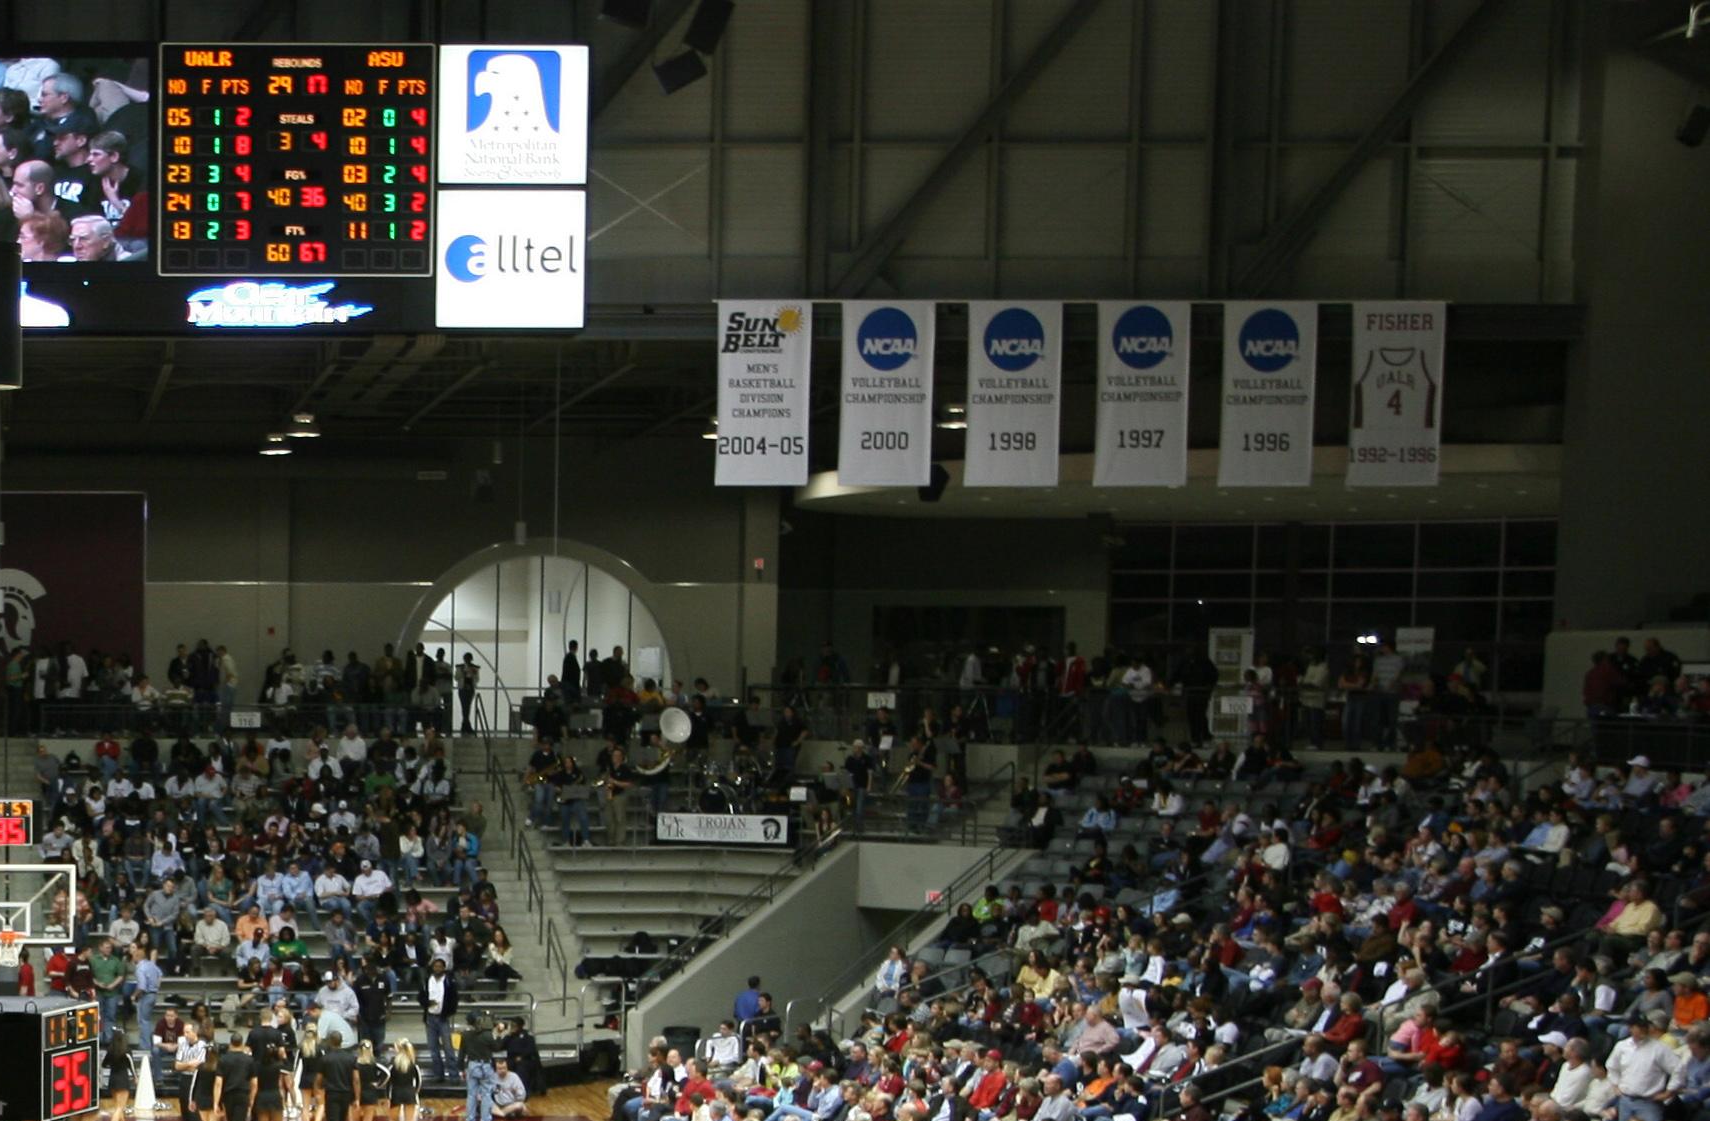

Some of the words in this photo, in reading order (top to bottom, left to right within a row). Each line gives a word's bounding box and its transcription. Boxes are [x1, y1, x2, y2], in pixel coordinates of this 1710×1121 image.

[184, 51, 233, 67] UALR
[272, 58, 322, 68] REBOUNDS
[367, 51, 404, 67] ASU
[168, 79, 187, 95] NO
[201, 79, 212, 95] F
[221, 79, 250, 95] PTS
[267, 75, 292, 95] 29
[345, 79, 364, 95] NO
[378, 79, 389, 95] F
[397, 79, 426, 95] PTS
[167, 108, 191, 126] 05
[214, 108, 220, 126] 1
[235, 106, 252, 126] 2
[279, 114, 314, 124] STEALS
[342, 108, 367, 127] 02
[383, 108, 395, 127] 0
[410, 107, 428, 127] 4
[174, 136, 191, 155] 10
[214, 137, 220, 154] 1
[235, 135, 252, 155] 8
[279, 132, 291, 150] 3
[311, 131, 328, 150] 4
[349, 136, 367, 155] 10
[389, 137, 395, 155] 1
[410, 136, 427, 155] 4
[167, 165, 191, 183] 23
[208, 165, 220, 183] 3
[235, 164, 251, 183] 4
[285, 170, 307, 180] FG%
[343, 165, 367, 183] 03
[383, 165, 396, 184] 2
[411, 165, 427, 183] 4
[167, 193, 191, 211] 24
[207, 193, 219, 211] 0
[235, 192, 251, 211] 7
[267, 187, 290, 206] 40
[300, 186, 327, 208] 36
[343, 193, 367, 211] 40
[383, 193, 396, 212] 3
[411, 192, 427, 212] 2
[173, 221, 191, 239] 13
[207, 222, 219, 240] 2
[235, 220, 251, 240] 3
[285, 226, 306, 236] FT%
[349, 222, 367, 239] 11
[389, 222, 395, 240] 1
[410, 220, 427, 240] 2
[266, 243, 291, 262] 60
[299, 242, 327, 262] 67
[454, 235, 577, 278] alltel
[727, 312, 779, 333] SUN
[1366, 313, 1433, 331] FISHER
[721, 333, 787, 354] BELT
[863, 338, 915, 356] NCAA
[989, 338, 1043, 356] NCAA
[1118, 336, 1170, 354] NCAA
[1245, 339, 1298, 357] NCAA
[747, 363, 779, 374] MEN'S
[728, 378, 796, 389] BASKETBALL
[851, 377, 922, 388] VOLLEYBALL
[978, 378, 1049, 389] VOLLEYBALL
[1106, 375, 1177, 387] VOLLEYBALL
[1232, 378, 1303, 390] VOLLEYBALL
[739, 393, 784, 404] DIVISION
[845, 393, 928, 405] CHAMPIONSHIP
[972, 393, 1054, 405] CHAMPIONSHIP
[1387, 389, 1402, 416] 4
[732, 407, 791, 419] CHAMPIONS
[718, 436, 804, 456] 2004-05
[861, 432, 909, 451] 2000
[989, 432, 1037, 451] 1998
[1117, 430, 1165, 449] 1997
[1242, 433, 1291, 452] 1996
[1348, 447, 1436, 464] 1992-1996
[50, 1007, 98, 1045] 11:57
[52, 1051, 91, 1116] 35
